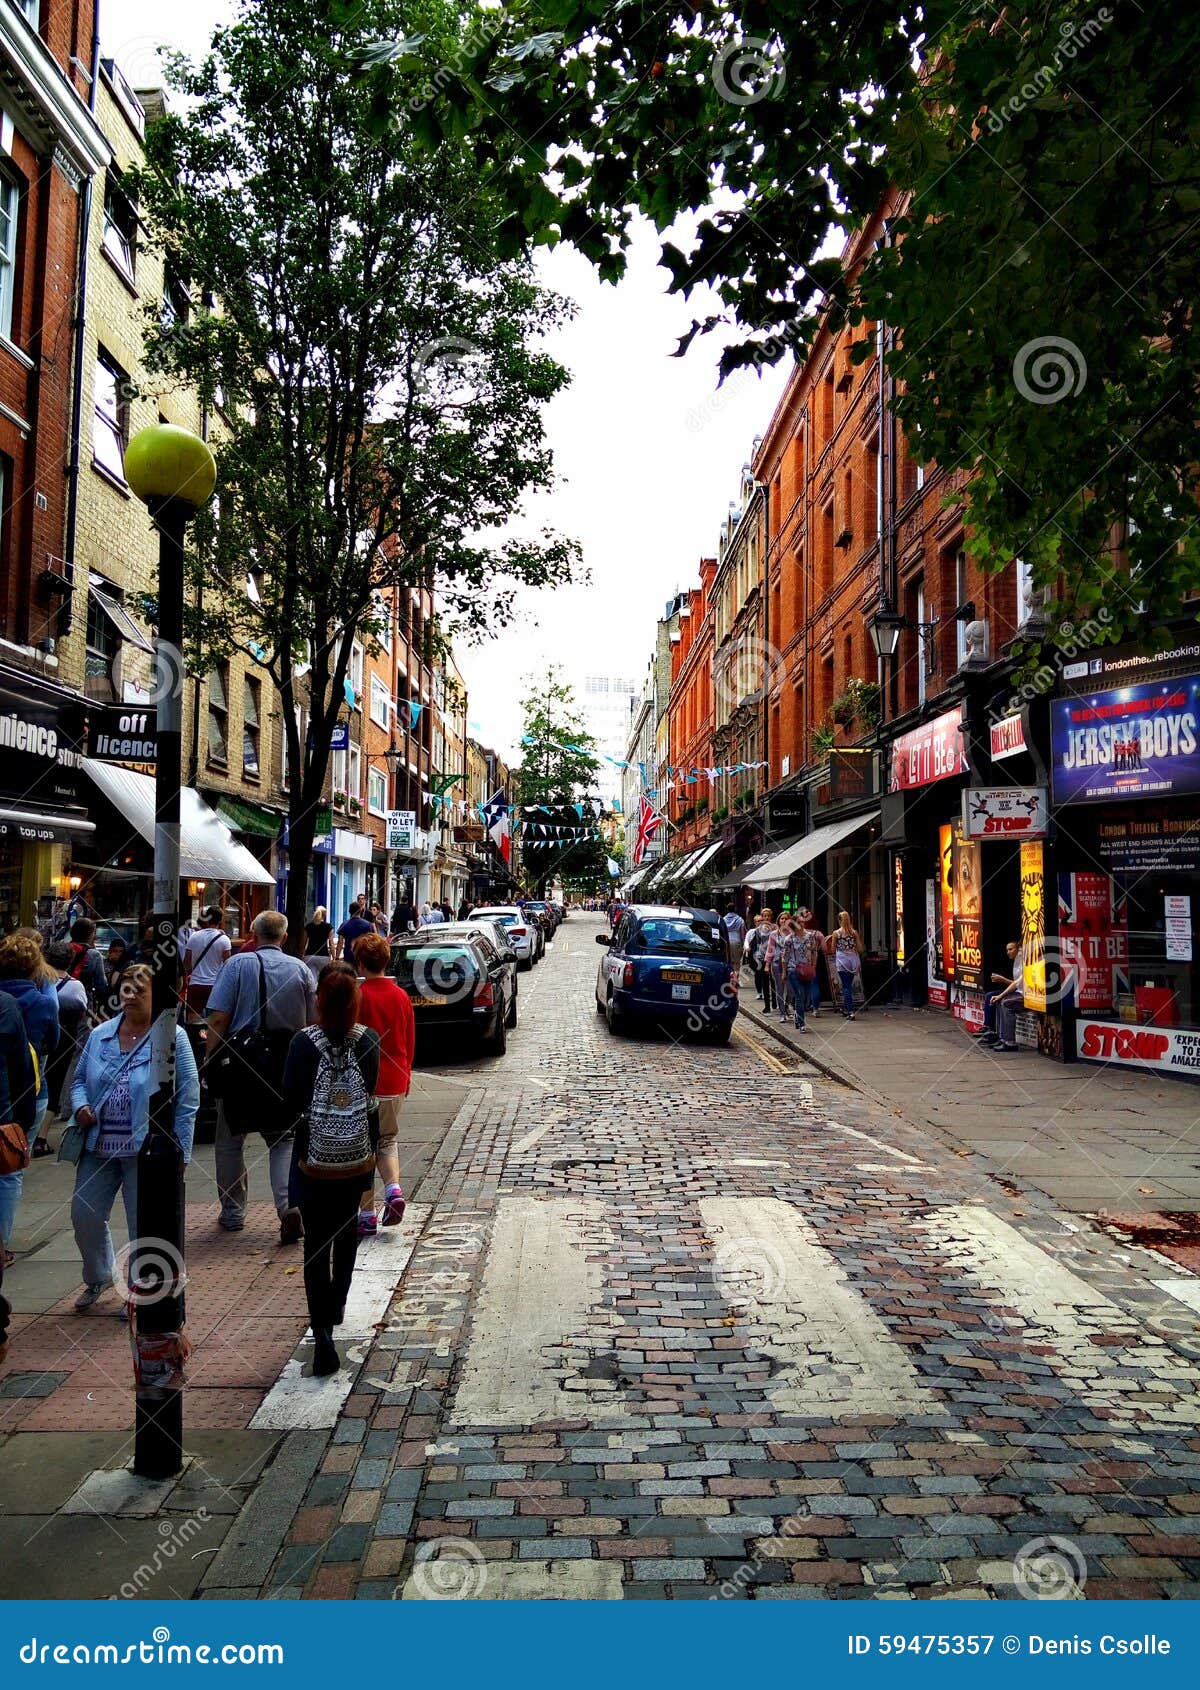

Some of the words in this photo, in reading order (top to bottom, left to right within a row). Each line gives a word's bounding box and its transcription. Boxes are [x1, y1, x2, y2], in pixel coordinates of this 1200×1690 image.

[119, 714, 148, 734] off
[1063, 720, 1135, 769] JERSEY
[1140, 712, 1197, 759] BOYS
[58, 748, 83, 770] store
[909, 743, 922, 785] LET
[923, 737, 932, 780] IT
[934, 731, 947, 777] BE
[400, 818, 414, 826] LET
[983, 816, 1032, 833] STOMP
[1100, 823, 1126, 837] LONDON
[1129, 821, 1159, 835] THEATRE
[1163, 819, 1200, 832] BOOKINGS
[20, 826, 36, 839] top
[37, 830, 55, 840] ups
[960, 924, 979, 947] War
[956, 942, 982, 967] Horse
[1062, 937, 1083, 959] LET
[1089, 937, 1100, 959] IT
[1105, 937, 1126, 959] BE
[1081, 1024, 1169, 1061] STOMP
[1174, 1034, 1200, 1046] 'EXPE
[1182, 1045, 1194, 1056] TO
